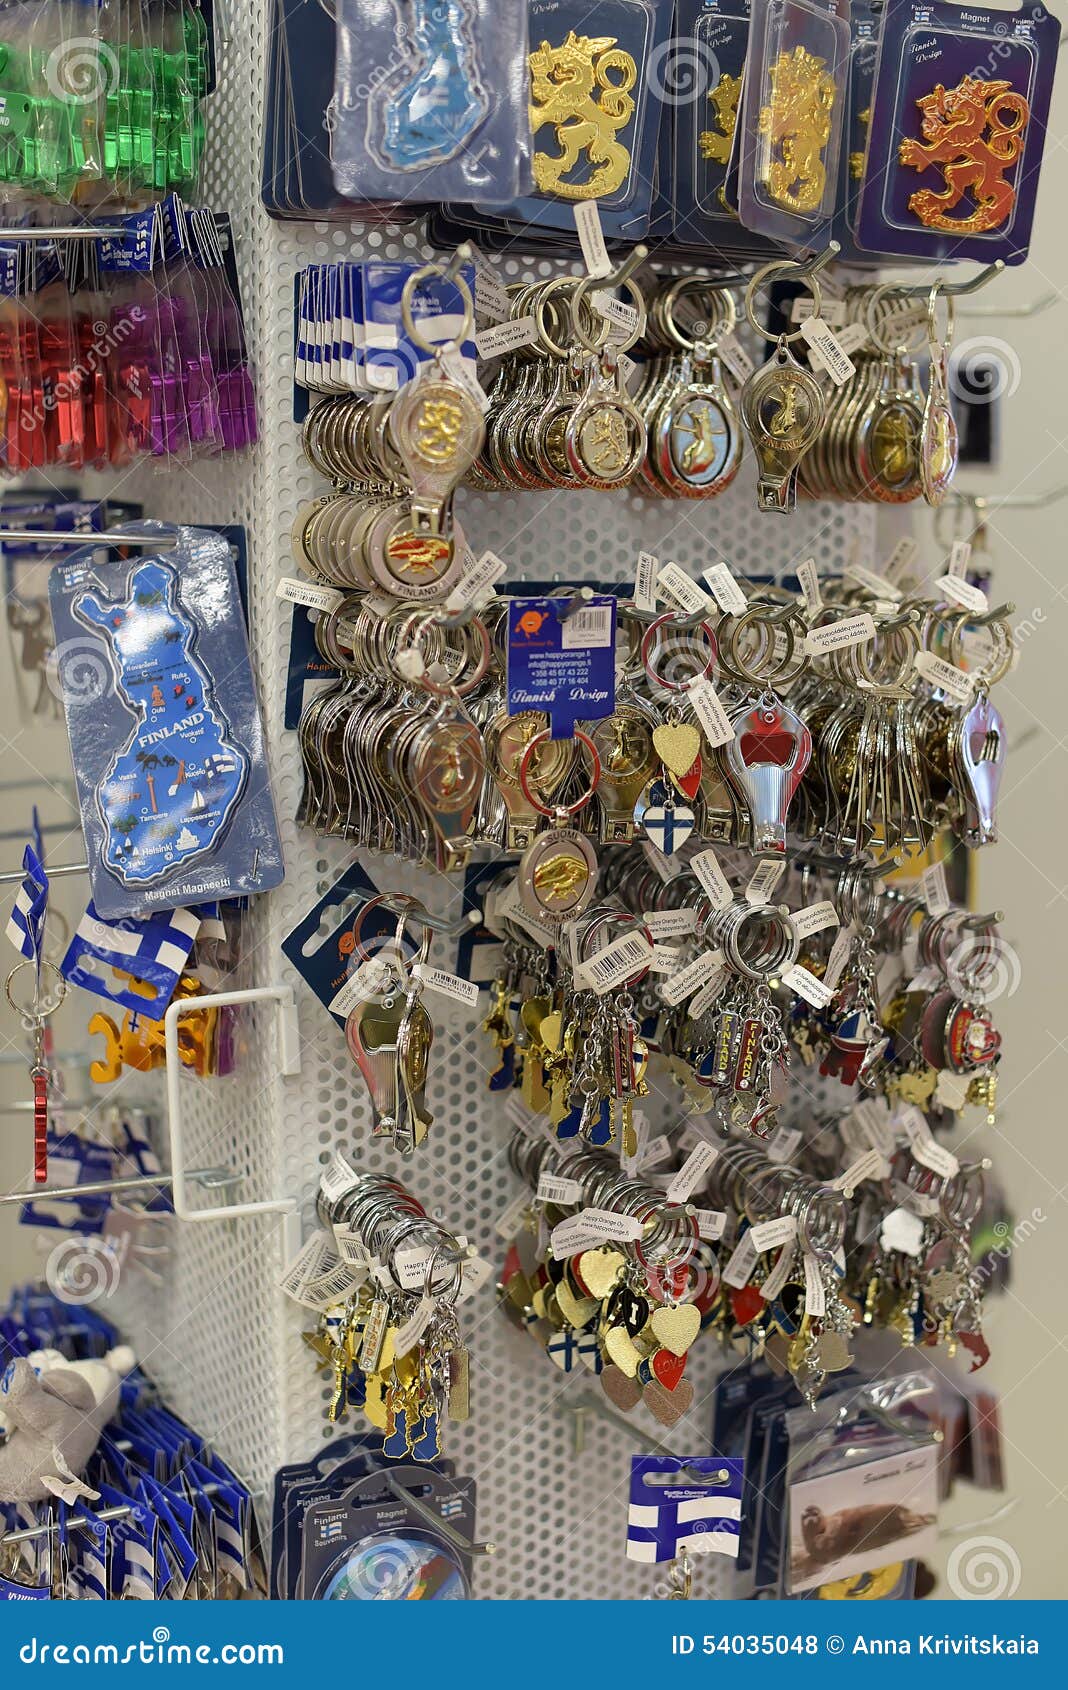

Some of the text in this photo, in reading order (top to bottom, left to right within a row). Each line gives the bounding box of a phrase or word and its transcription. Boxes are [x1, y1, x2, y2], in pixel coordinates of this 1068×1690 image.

[960, 12, 991, 23] Magnet
[397, 585, 438, 597] FINLAND
[821, 627, 867, 647] Happy Orange Oy
[171, 672, 188, 681] Ruka
[576, 668, 588, 676] 222
[569, 687, 608, 702] Design
[698, 703, 714, 724] Orange
[138, 712, 205, 748] FINLAND
[708, 722, 722, 739] Happy
[547, 830, 578, 843] SUOMI
[142, 842, 173, 856] Helsinki
[698, 855, 712, 871] Happy
[707, 869, 720, 887] Orange
[144, 877, 231, 901] Magnet Magneetti
[667, 980, 684, 995] Happy
[681, 967, 700, 983] Orange
[719, 1015, 733, 1070] FINLAND
[742, 1023, 758, 1077] FINLAND
[698, 1148, 712, 1166] Happy
[686, 1163, 701, 1182] Orange
[583, 1213, 598, 1222] Happy
[598, 1216, 616, 1226] Orange
[403, 1260, 423, 1271] Happy
[657, 1357, 684, 1374] LOVE
[297, 1494, 331, 1507] Finland
[313, 1512, 349, 1526] Finland
[376, 1508, 408, 1520] Magnet
[314, 1534, 348, 1547] Souvenirs
